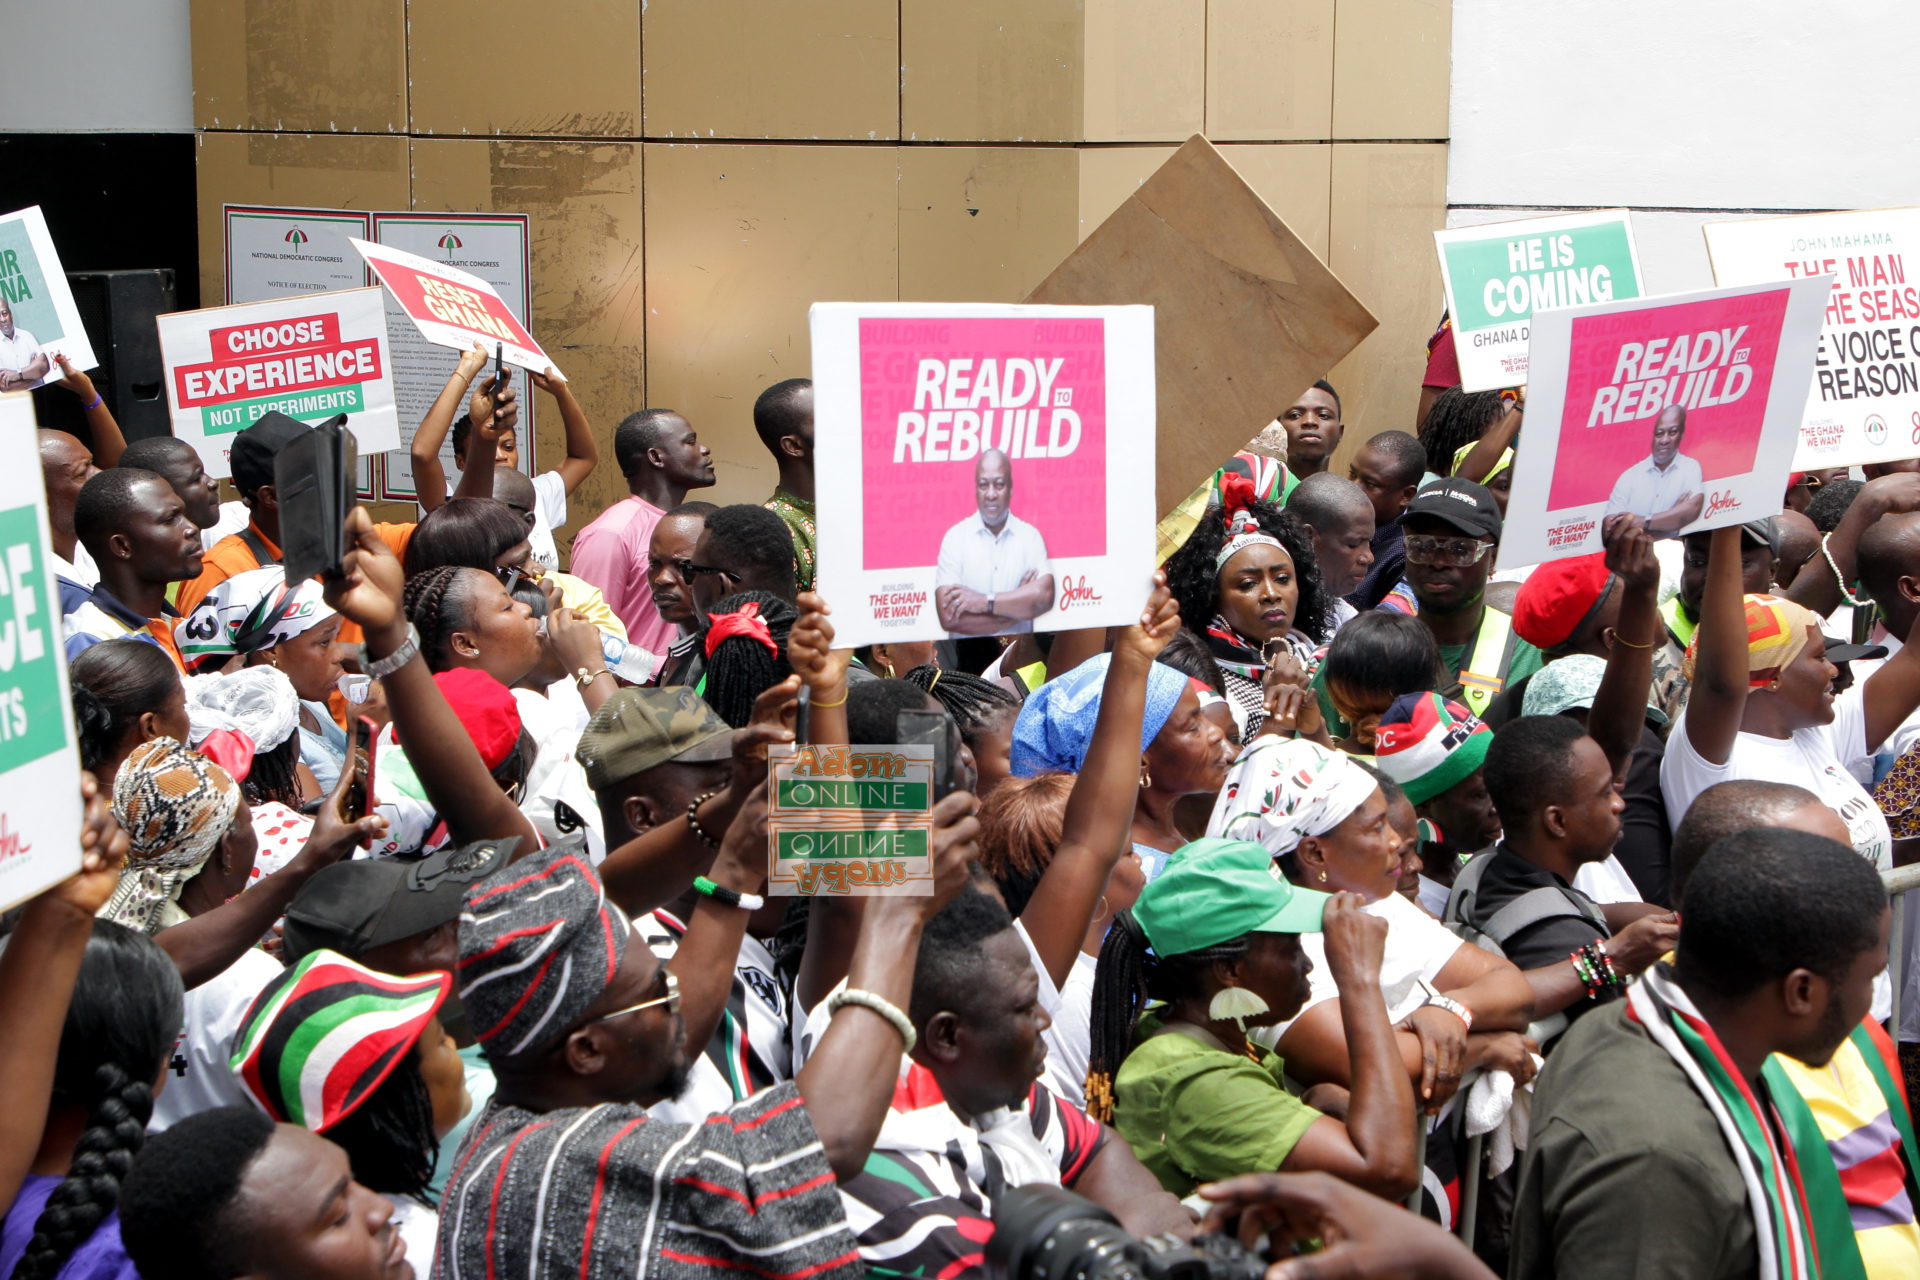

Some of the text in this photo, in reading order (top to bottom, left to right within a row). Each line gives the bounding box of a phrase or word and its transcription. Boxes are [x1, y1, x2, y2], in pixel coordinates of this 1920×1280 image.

[251, 252, 343, 263] NATIONAL DEMOCRATIC CONGRESS
[1507, 234, 1575, 273] HE IS
[1791, 233, 1894, 252] JOHN MAHAMA
[267, 280, 288, 288] NOTICE
[298, 282, 327, 291] ELECTION
[1846, 254, 1905, 288] MAN
[415, 275, 488, 312] RESET
[1483, 264, 1613, 317] COMING
[1859, 287, 1920, 323] SEAS
[424, 295, 521, 345] GHANA
[227, 319, 325, 353] CHOOSE
[1473, 328, 1518, 348] GHANA
[1832, 328, 1905, 365] VOICE
[1513, 357, 1529, 365] GHA
[1611, 325, 1749, 385] READY TO
[184, 346, 375, 400] EXPERIENCE
[914, 358, 1065, 410] READY
[1056, 390, 1071, 404] TO
[1818, 362, 1919, 401] REASON
[1586, 365, 1753, 428] REBUILD
[210, 406, 243, 427] NOT
[1800, 424, 1845, 437] THE GHANA
[893, 408, 1082, 464] REBUILD
[1807, 435, 1842, 447] WE WANT
[1704, 489, 1743, 519] John
[1546, 520, 1596, 538] THE GHANA
[1548, 531, 1591, 546] WE WANT
[869, 591, 928, 606] THE GHANA
[881, 582, 915, 592] BUILDING
[1060, 575, 1103, 611] John
[284, 600, 315, 618] DC
[873, 604, 922, 619] WE WANT
[880, 618, 917, 628] TOGETHER
